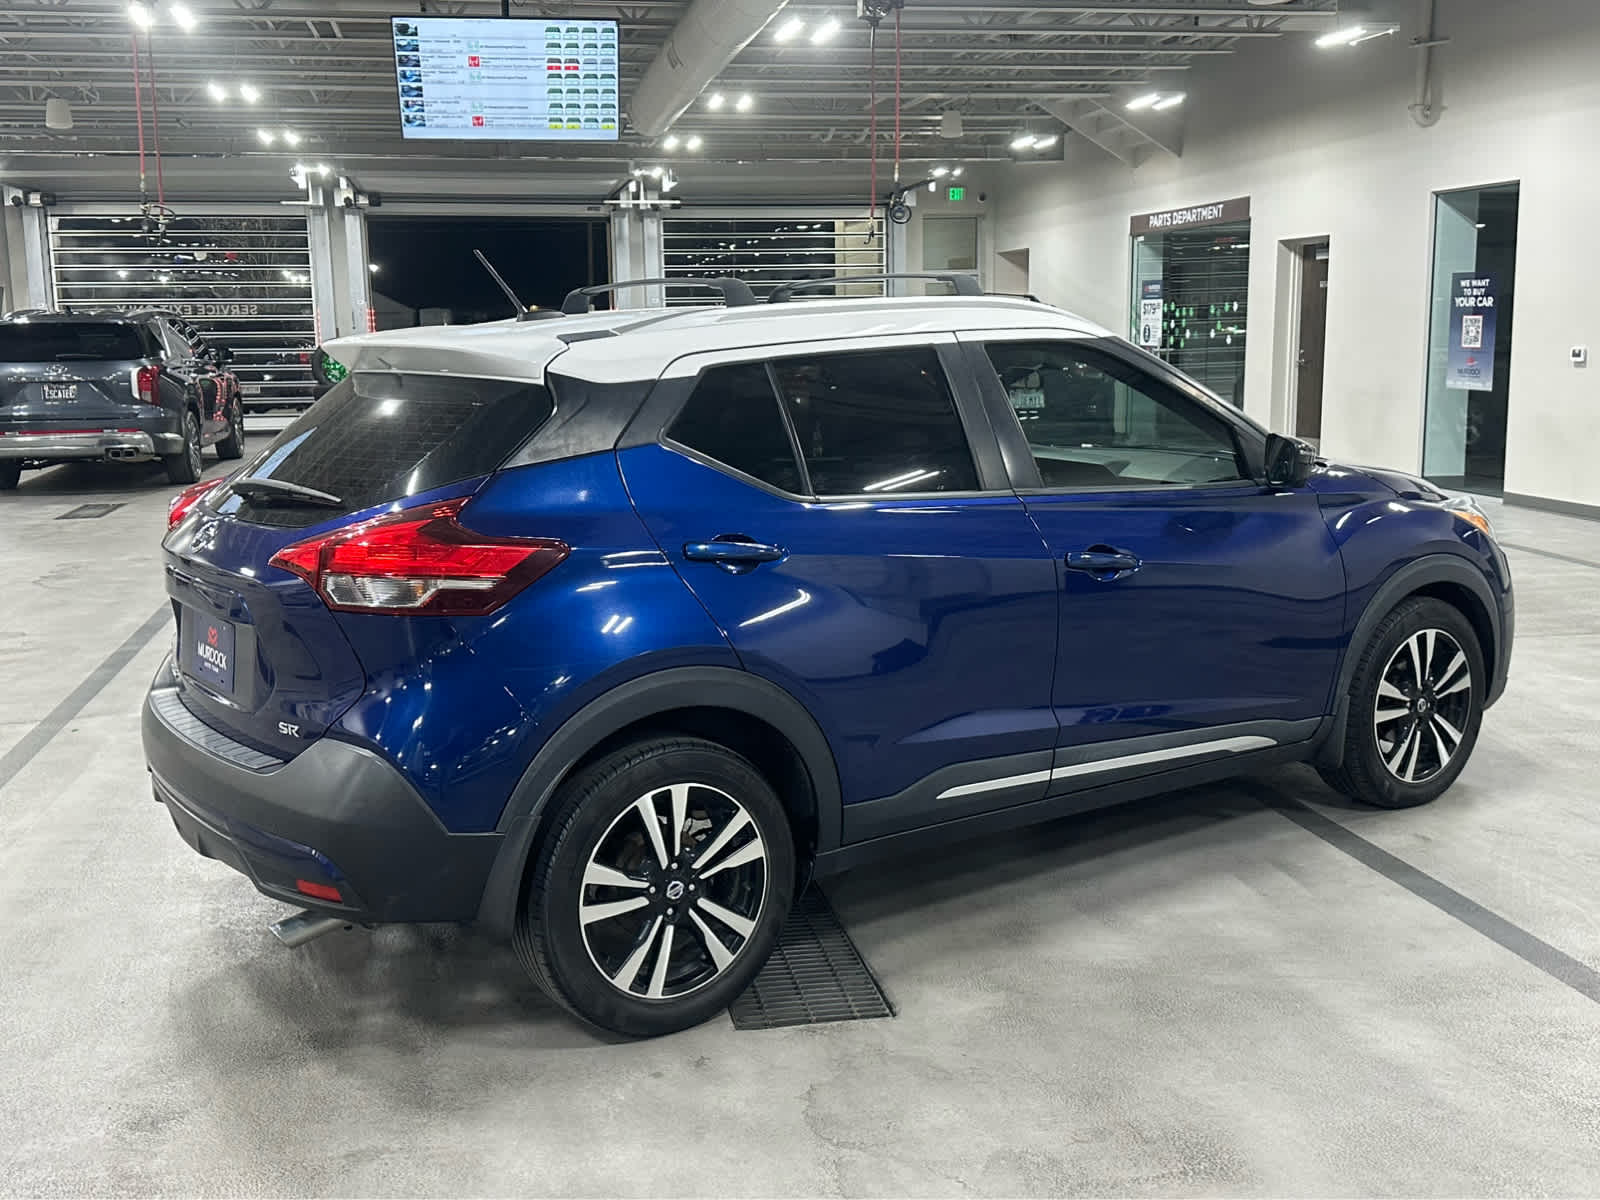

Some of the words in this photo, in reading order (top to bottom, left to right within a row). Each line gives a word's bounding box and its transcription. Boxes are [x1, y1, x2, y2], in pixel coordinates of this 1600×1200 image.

[1149, 213, 1171, 228] PARTS
[1172, 204, 1224, 225] DEPARTMENT
[1460, 279, 1470, 287] WE
[1471, 278, 1490, 287] WANT
[1463, 288, 1471, 296] TO
[1472, 287, 1485, 296] BUY
[1454, 296, 1476, 307] YOUR
[1476, 296, 1494, 307] CAR
[197, 639, 227, 670] MURDOCK
[278, 720, 300, 738] SR
